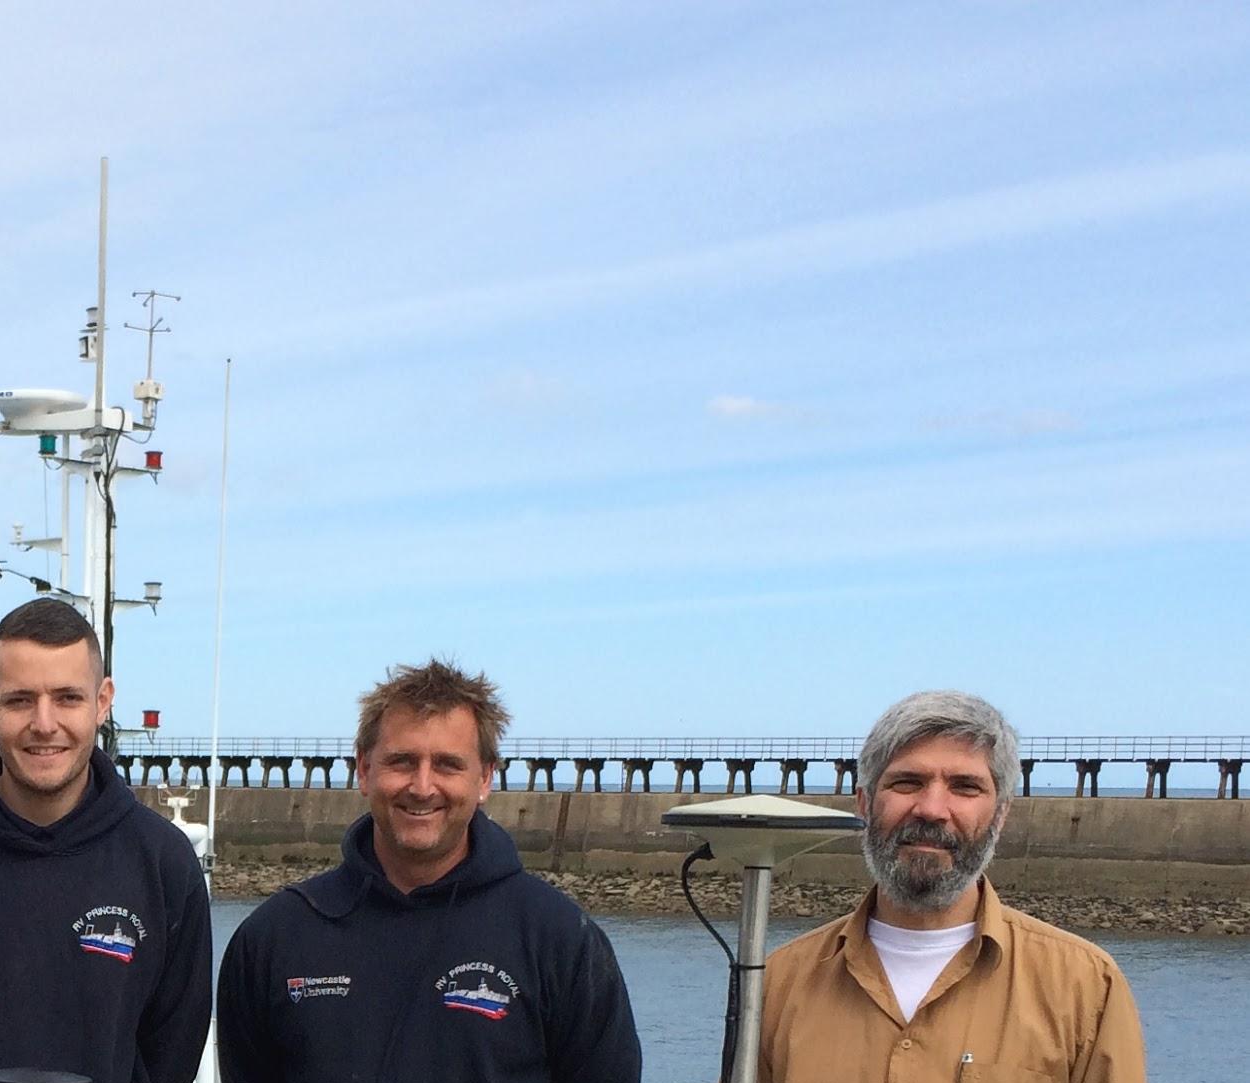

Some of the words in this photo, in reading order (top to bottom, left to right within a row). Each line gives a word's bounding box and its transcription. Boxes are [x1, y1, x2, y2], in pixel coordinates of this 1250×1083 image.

[85, 905, 129, 921] PRINCESS
[129, 913, 148, 941] ROYAL
[305, 975, 351, 986] Newcastle
[448, 961, 495, 979] PRINCESS
[497, 969, 521, 998] ROYAL
[303, 986, 350, 998] University
